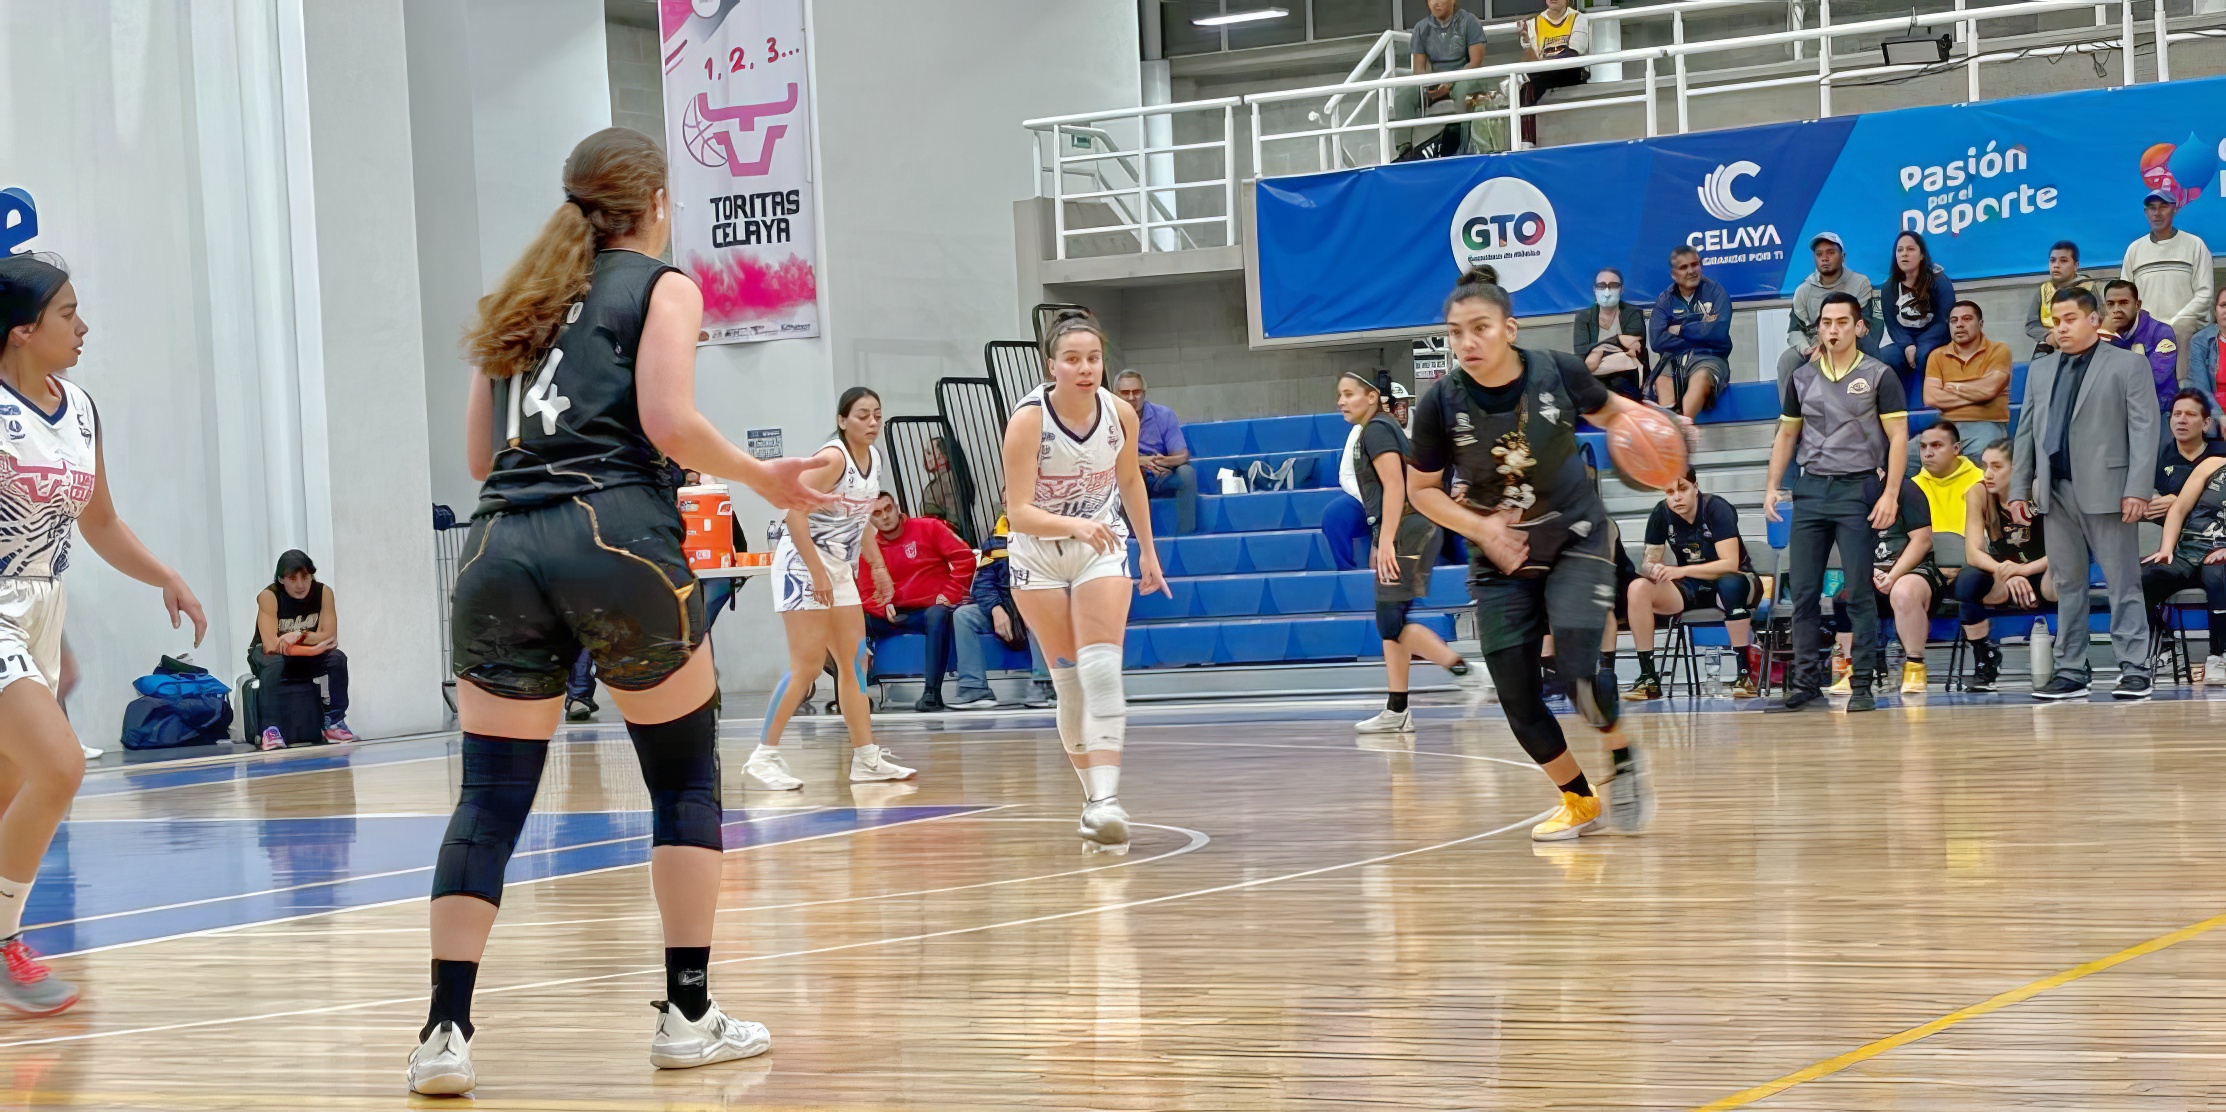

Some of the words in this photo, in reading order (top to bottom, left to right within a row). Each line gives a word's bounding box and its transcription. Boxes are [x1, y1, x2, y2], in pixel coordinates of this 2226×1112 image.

[704, 57, 722, 80] 1,
[729, 46, 754, 73] 2,
[766, 37, 800, 63] 3...
[1899, 139, 2028, 192] Pasión
[709, 189, 800, 222] TORITAS
[1902, 184, 2059, 237] Deporte
[1927, 191, 1956, 211] por
[1958, 184, 1973, 200] el
[712, 217, 791, 248] CELAYA
[1462, 211, 1546, 250] GTO
[1686, 224, 1782, 252] CELAYA
